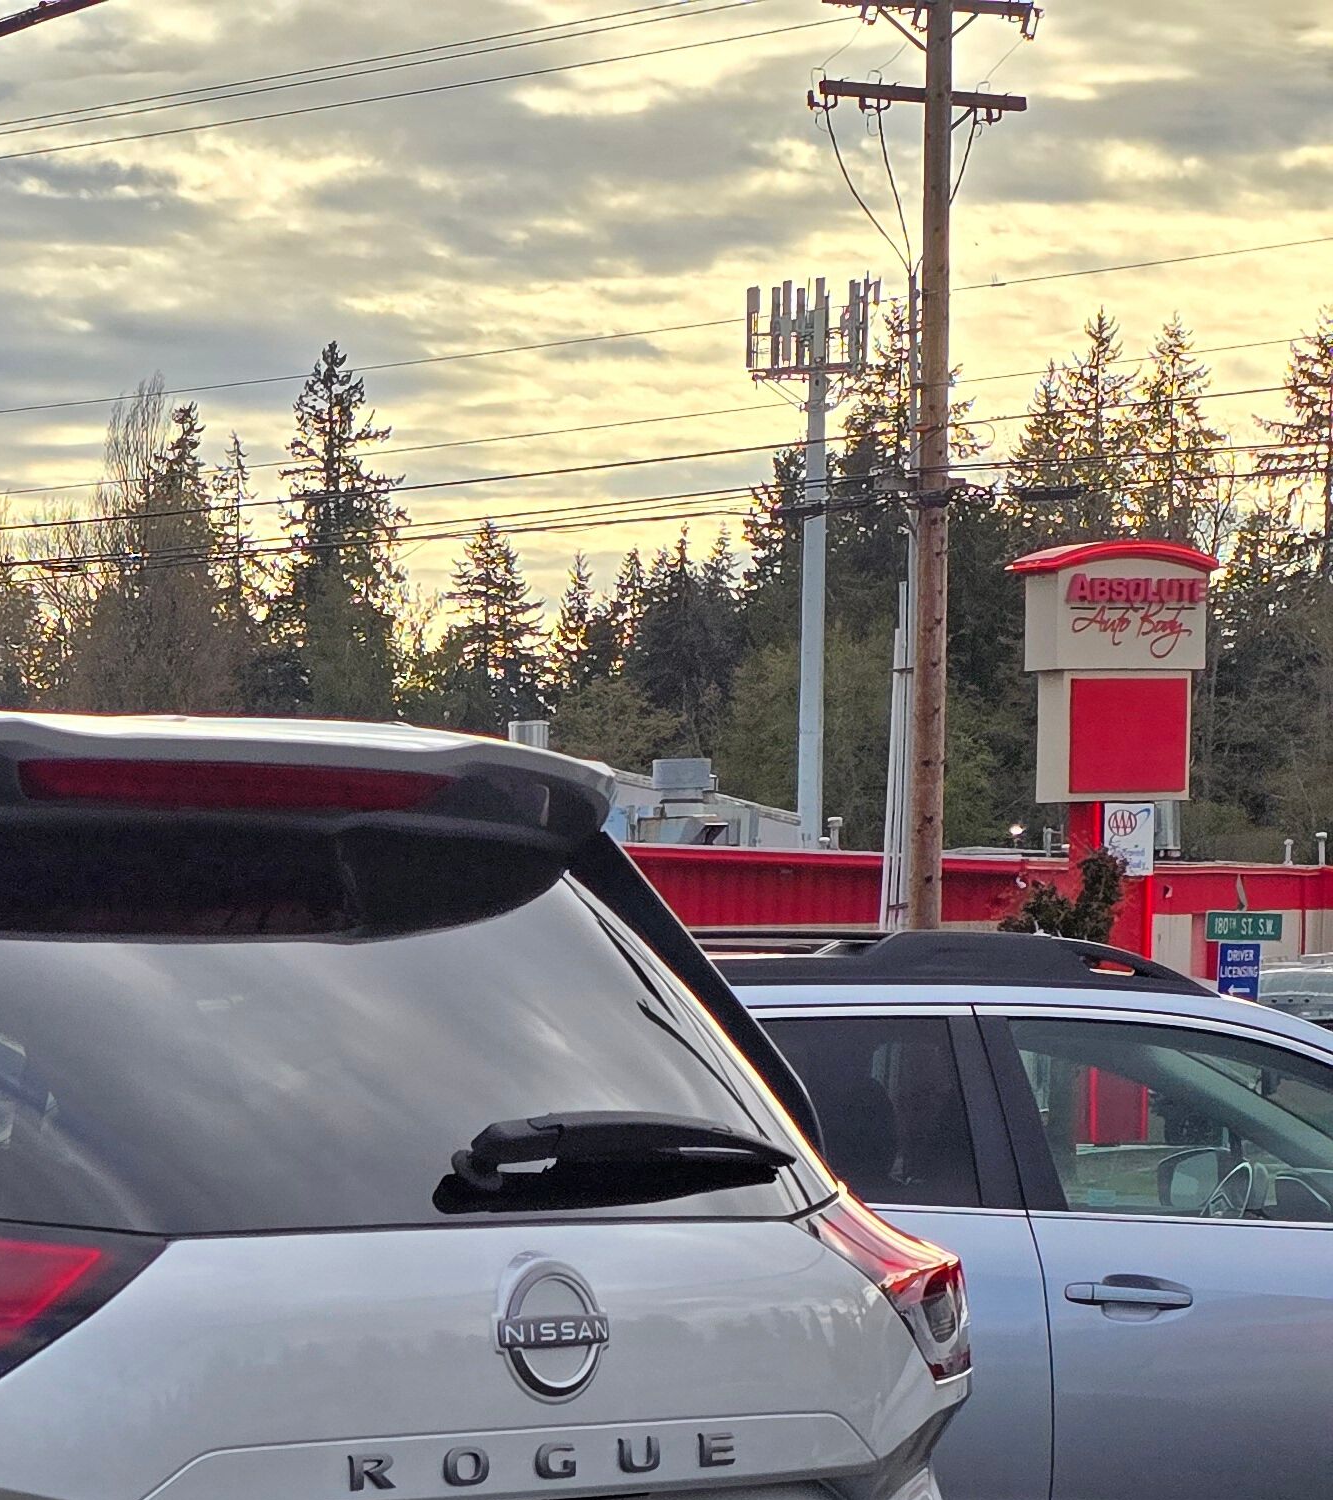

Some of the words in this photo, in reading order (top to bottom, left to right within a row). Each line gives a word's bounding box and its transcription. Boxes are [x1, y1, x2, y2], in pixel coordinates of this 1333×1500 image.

[1067, 573, 1207, 603] ABSOLUTE
[1072, 605, 1132, 645] Auto
[1137, 602, 1192, 658] Body
[1111, 811, 1134, 835] AAA
[1227, 949, 1254, 961] DRIVER
[1220, 966, 1258, 978] LICENSING
[504, 1319, 609, 1344] NISSAN
[347, 1432, 736, 1492] ROGUE
